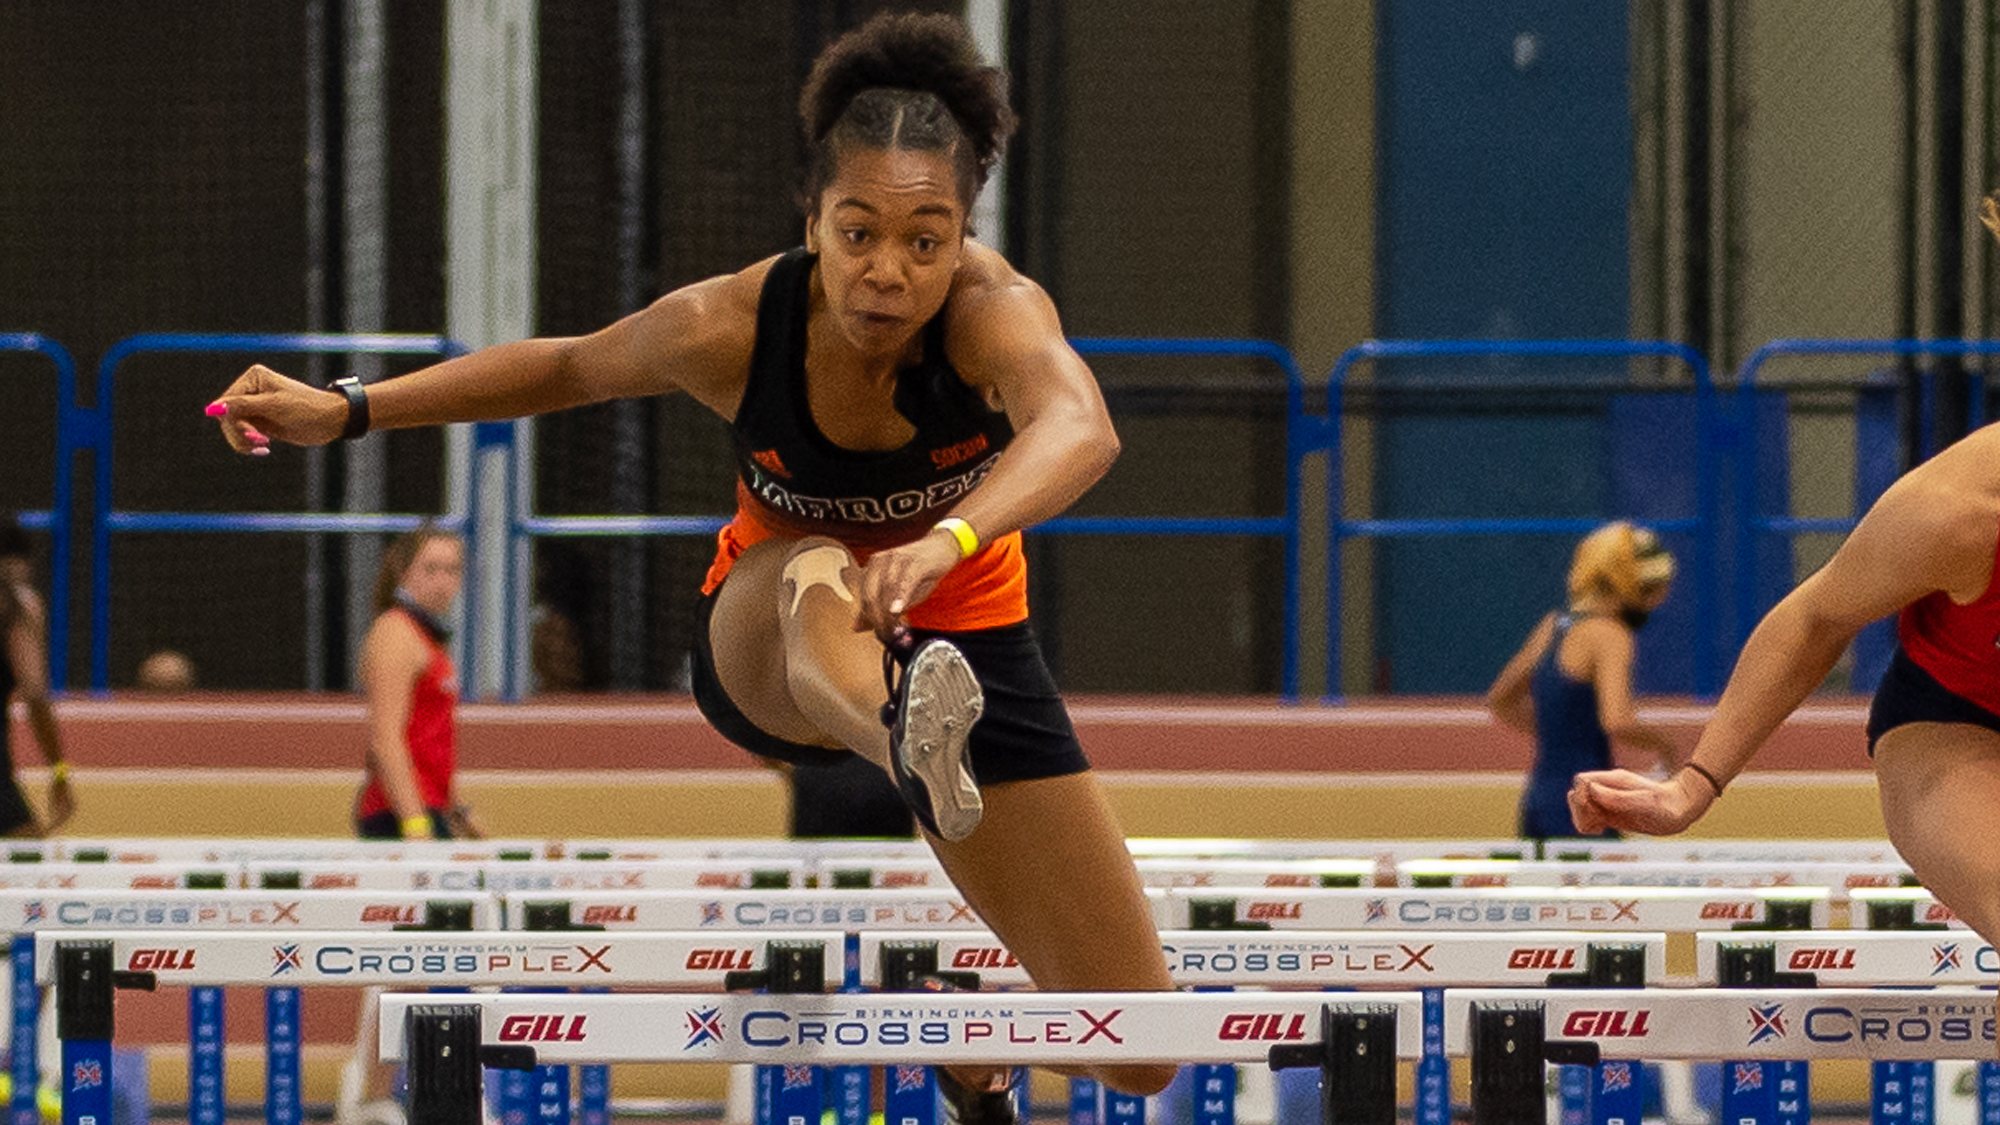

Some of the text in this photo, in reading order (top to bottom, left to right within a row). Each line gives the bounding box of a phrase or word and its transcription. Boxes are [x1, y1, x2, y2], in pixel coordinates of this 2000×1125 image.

[128, 949, 196, 970] GILL
[315, 945, 612, 975] CROSSPLEX
[686, 949, 754, 970] GILL
[1507, 948, 1575, 969] GILL
[1788, 948, 1856, 969] GILL
[856, 1009, 1014, 1018] BIRMINGHAM
[1562, 1010, 1650, 1037] GILL
[499, 1014, 587, 1042] GILL
[741, 1009, 1123, 1047] CROSSPLEX
[1219, 1013, 1306, 1041] GILL
